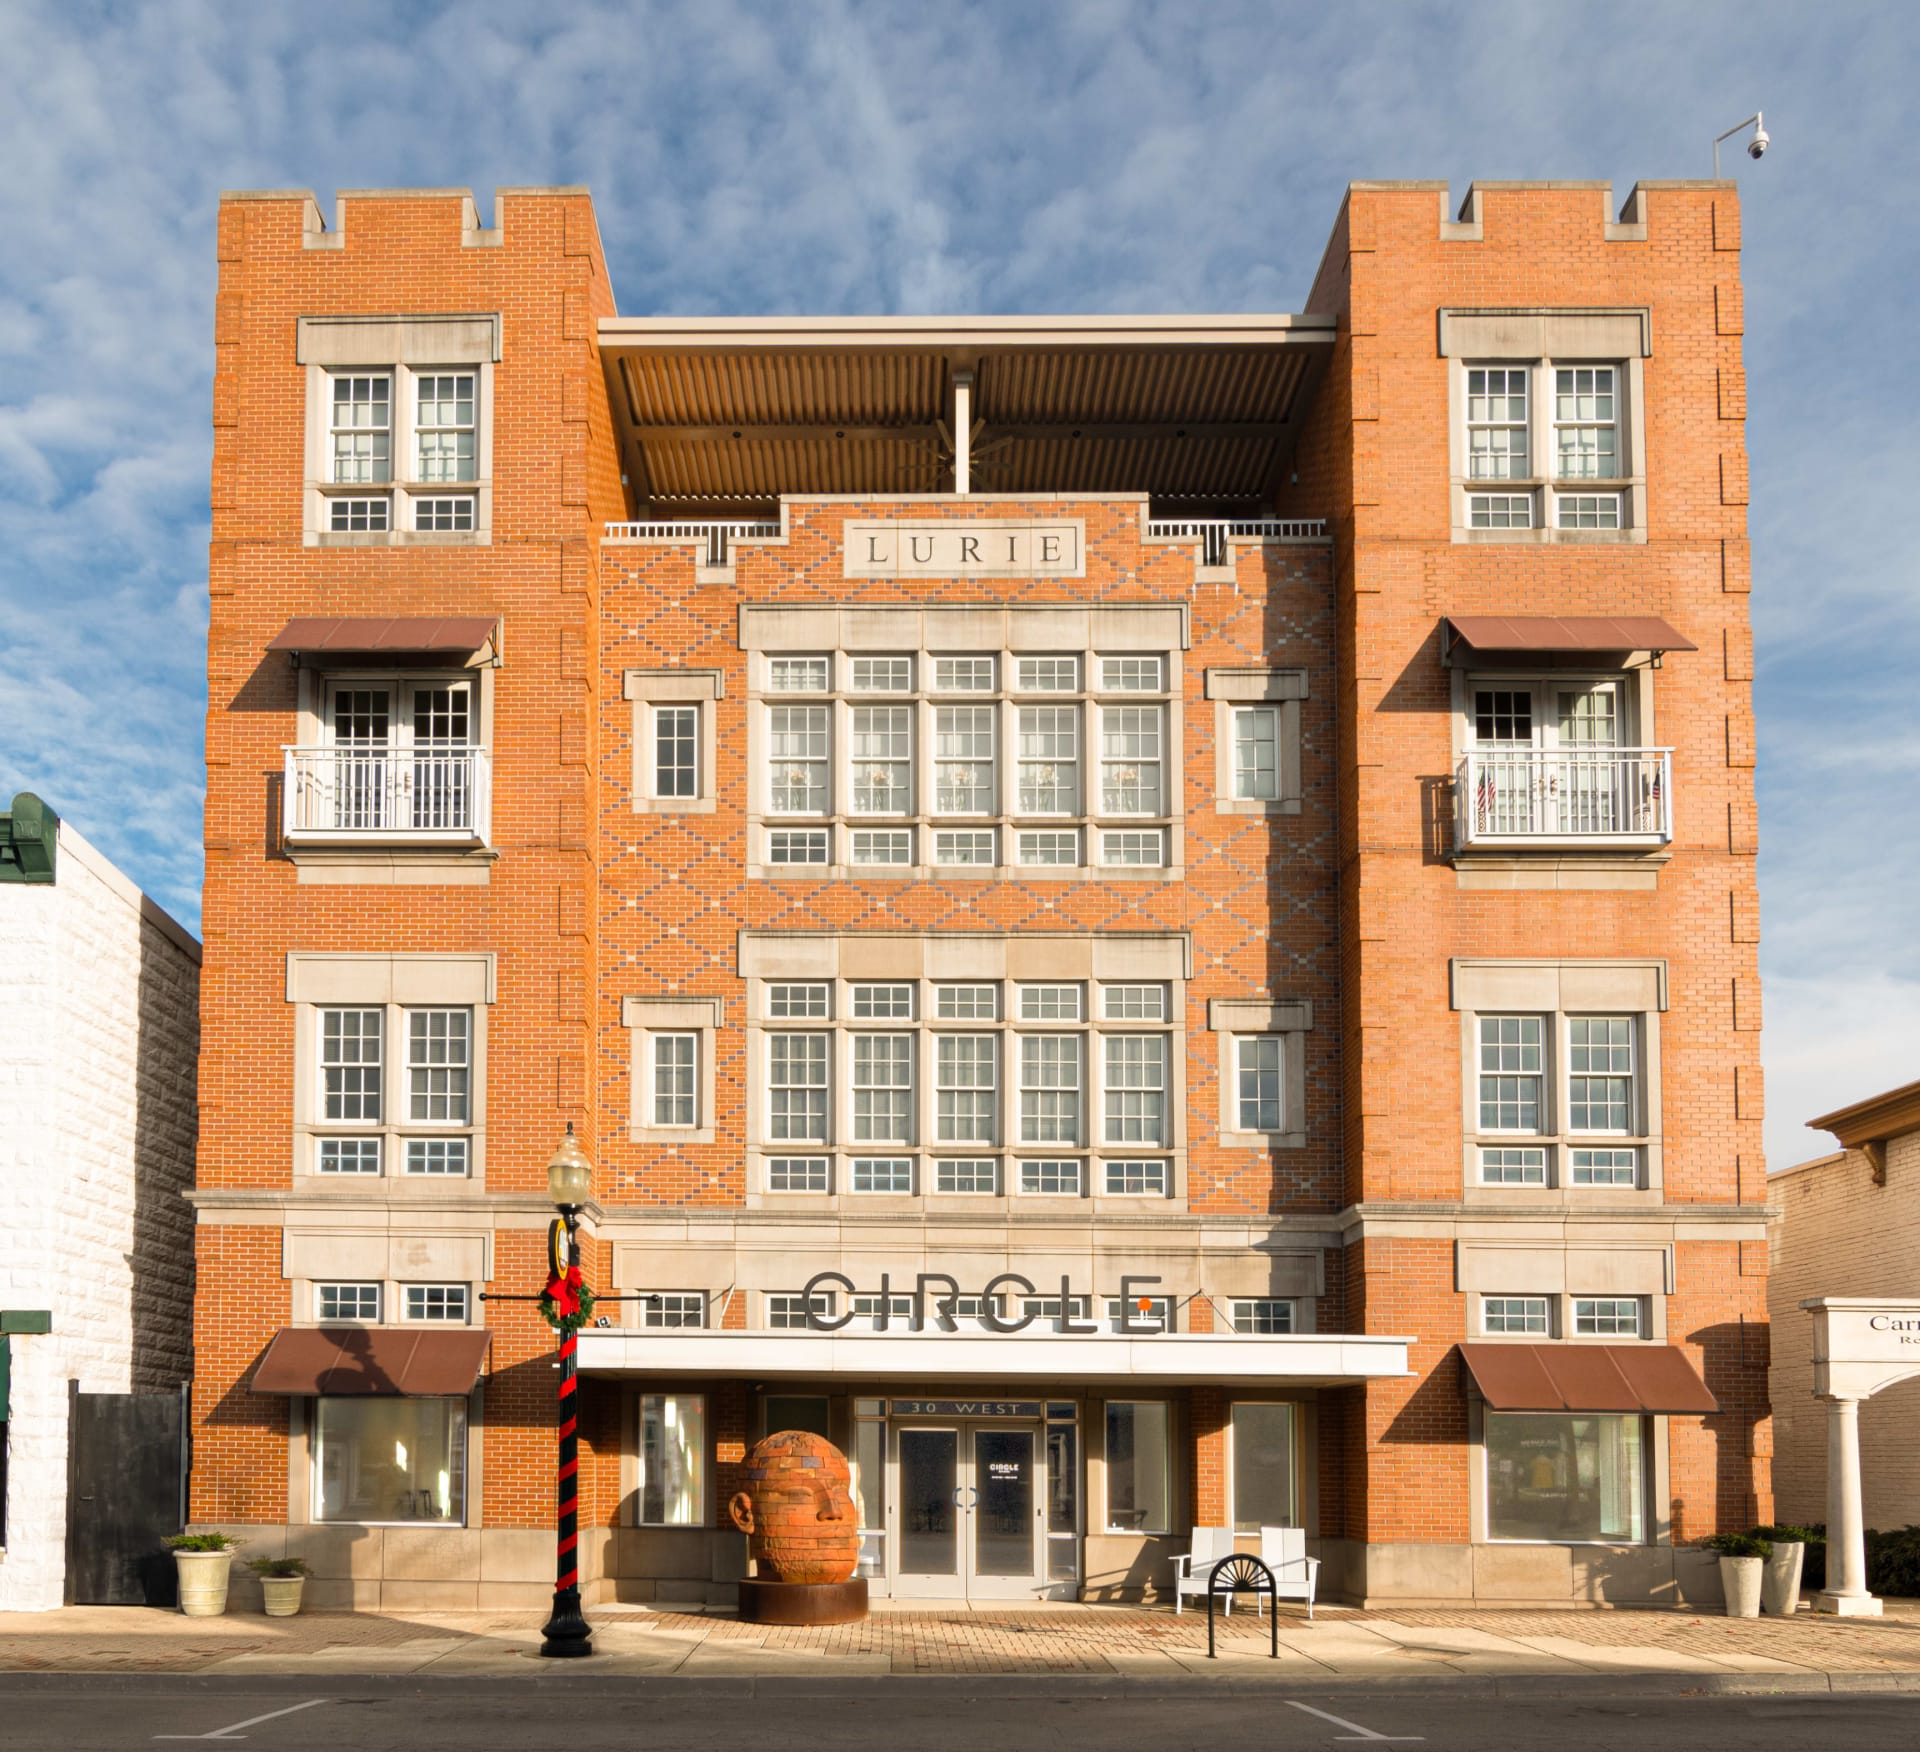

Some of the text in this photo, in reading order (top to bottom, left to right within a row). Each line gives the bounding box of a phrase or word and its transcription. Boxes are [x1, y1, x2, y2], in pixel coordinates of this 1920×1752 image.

[867, 536, 1061, 563] LURIE
[802, 1272, 1163, 1334] CIRCLE
[911, 1402, 1021, 1415] 30 WEST
